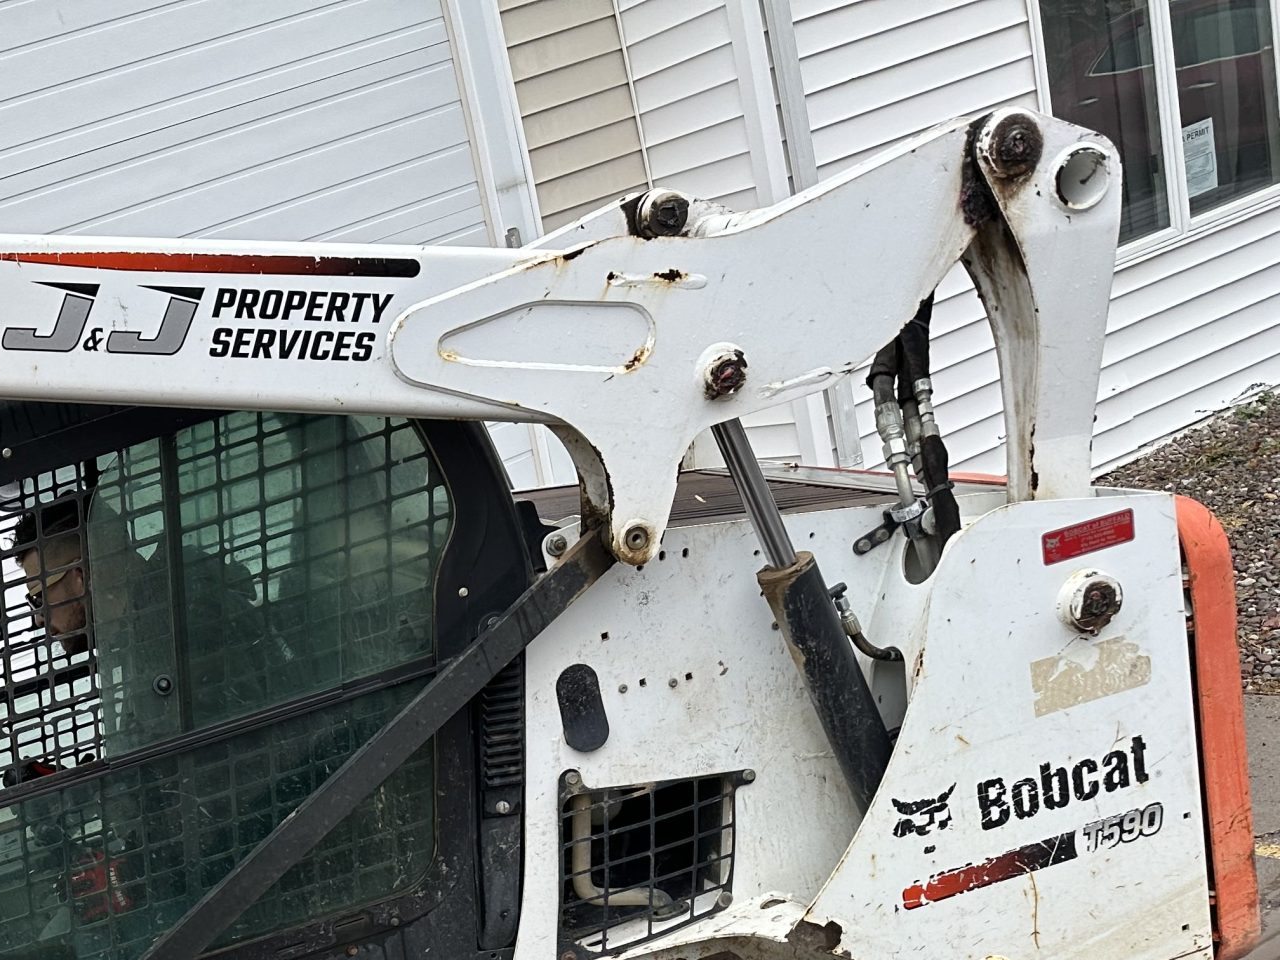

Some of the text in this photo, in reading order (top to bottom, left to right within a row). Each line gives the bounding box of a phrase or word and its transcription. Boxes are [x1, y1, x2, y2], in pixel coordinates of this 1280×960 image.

[1186, 127, 1209, 141] PERMIT
[211, 287, 395, 324] PROPERTY
[208, 328, 377, 362] SERVICES
[977, 735, 1150, 831] Bobcat
[1082, 802, 1164, 853] T590
